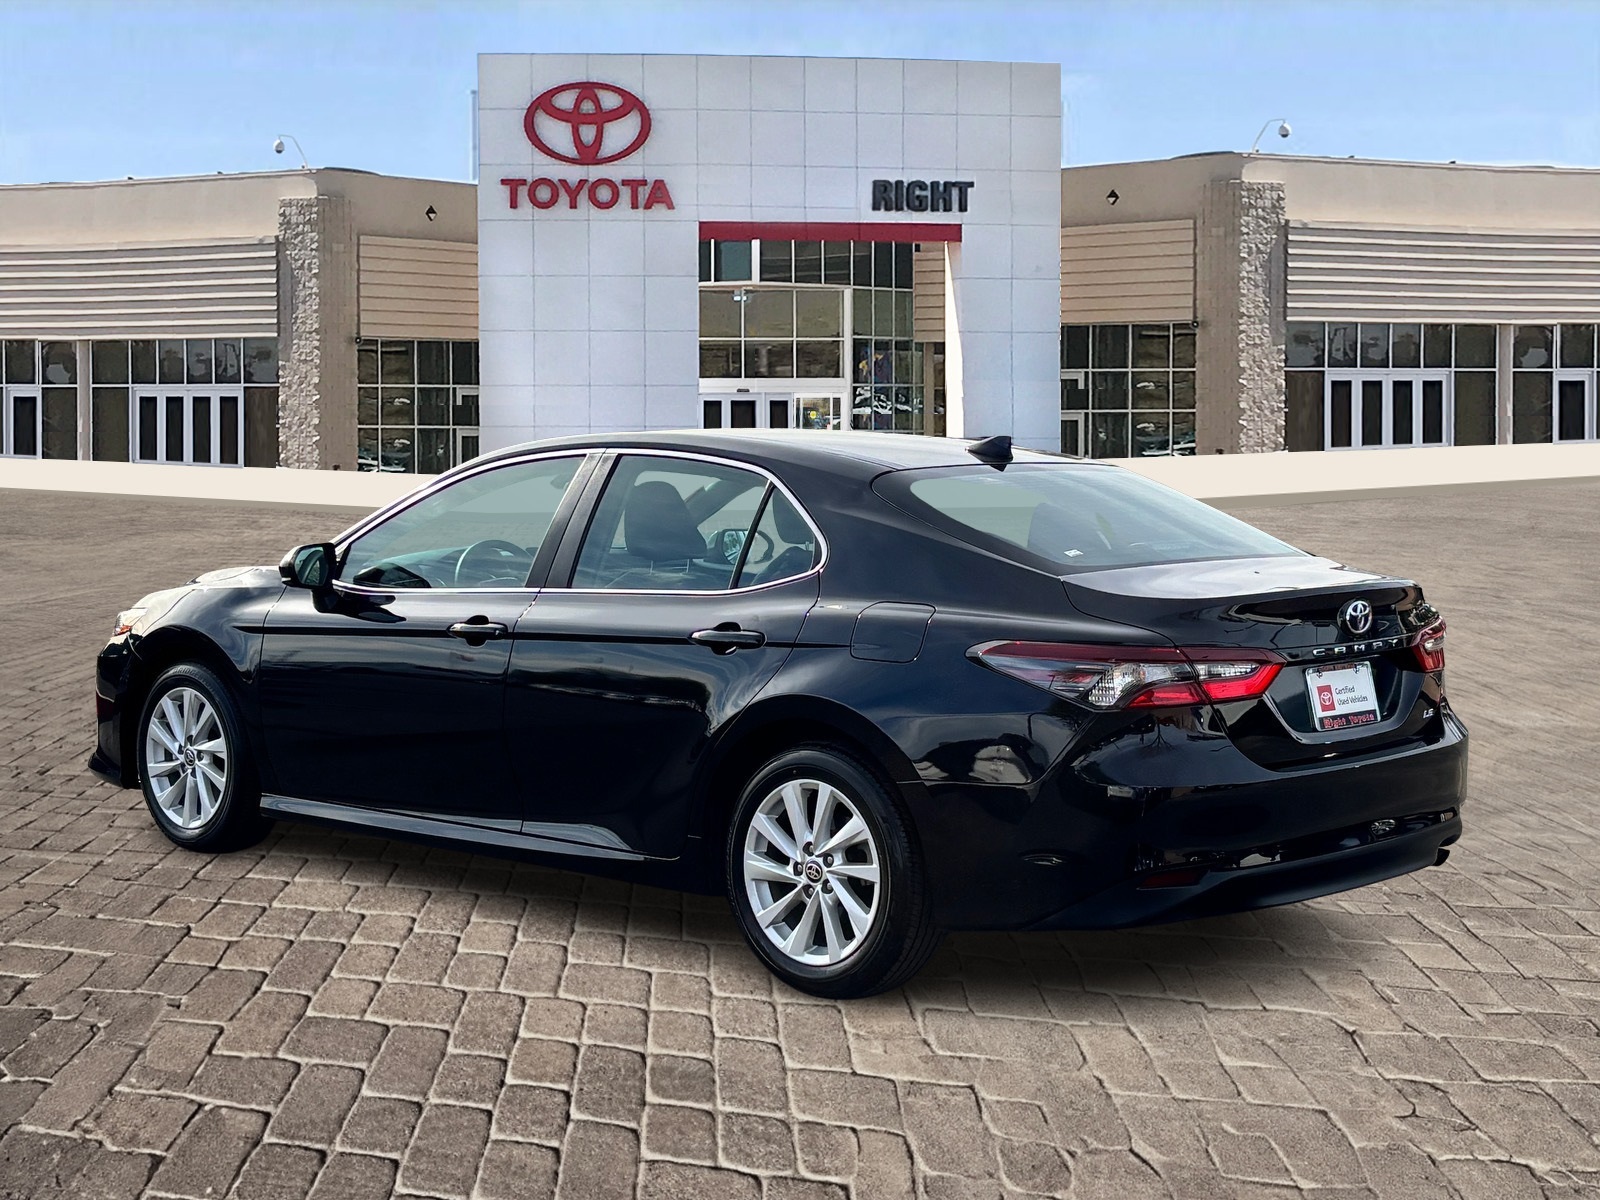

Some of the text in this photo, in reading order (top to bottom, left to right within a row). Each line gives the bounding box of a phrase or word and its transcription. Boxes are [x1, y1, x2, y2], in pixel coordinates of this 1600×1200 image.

[501, 178, 675, 210] TOYOTA
[872, 179, 975, 212] RIGHT
[1312, 639, 1399, 656] CAMRY
[1334, 685, 1356, 695] Certified
[1337, 694, 1369, 706] Used Vehicles
[1423, 708, 1434, 719] LE
